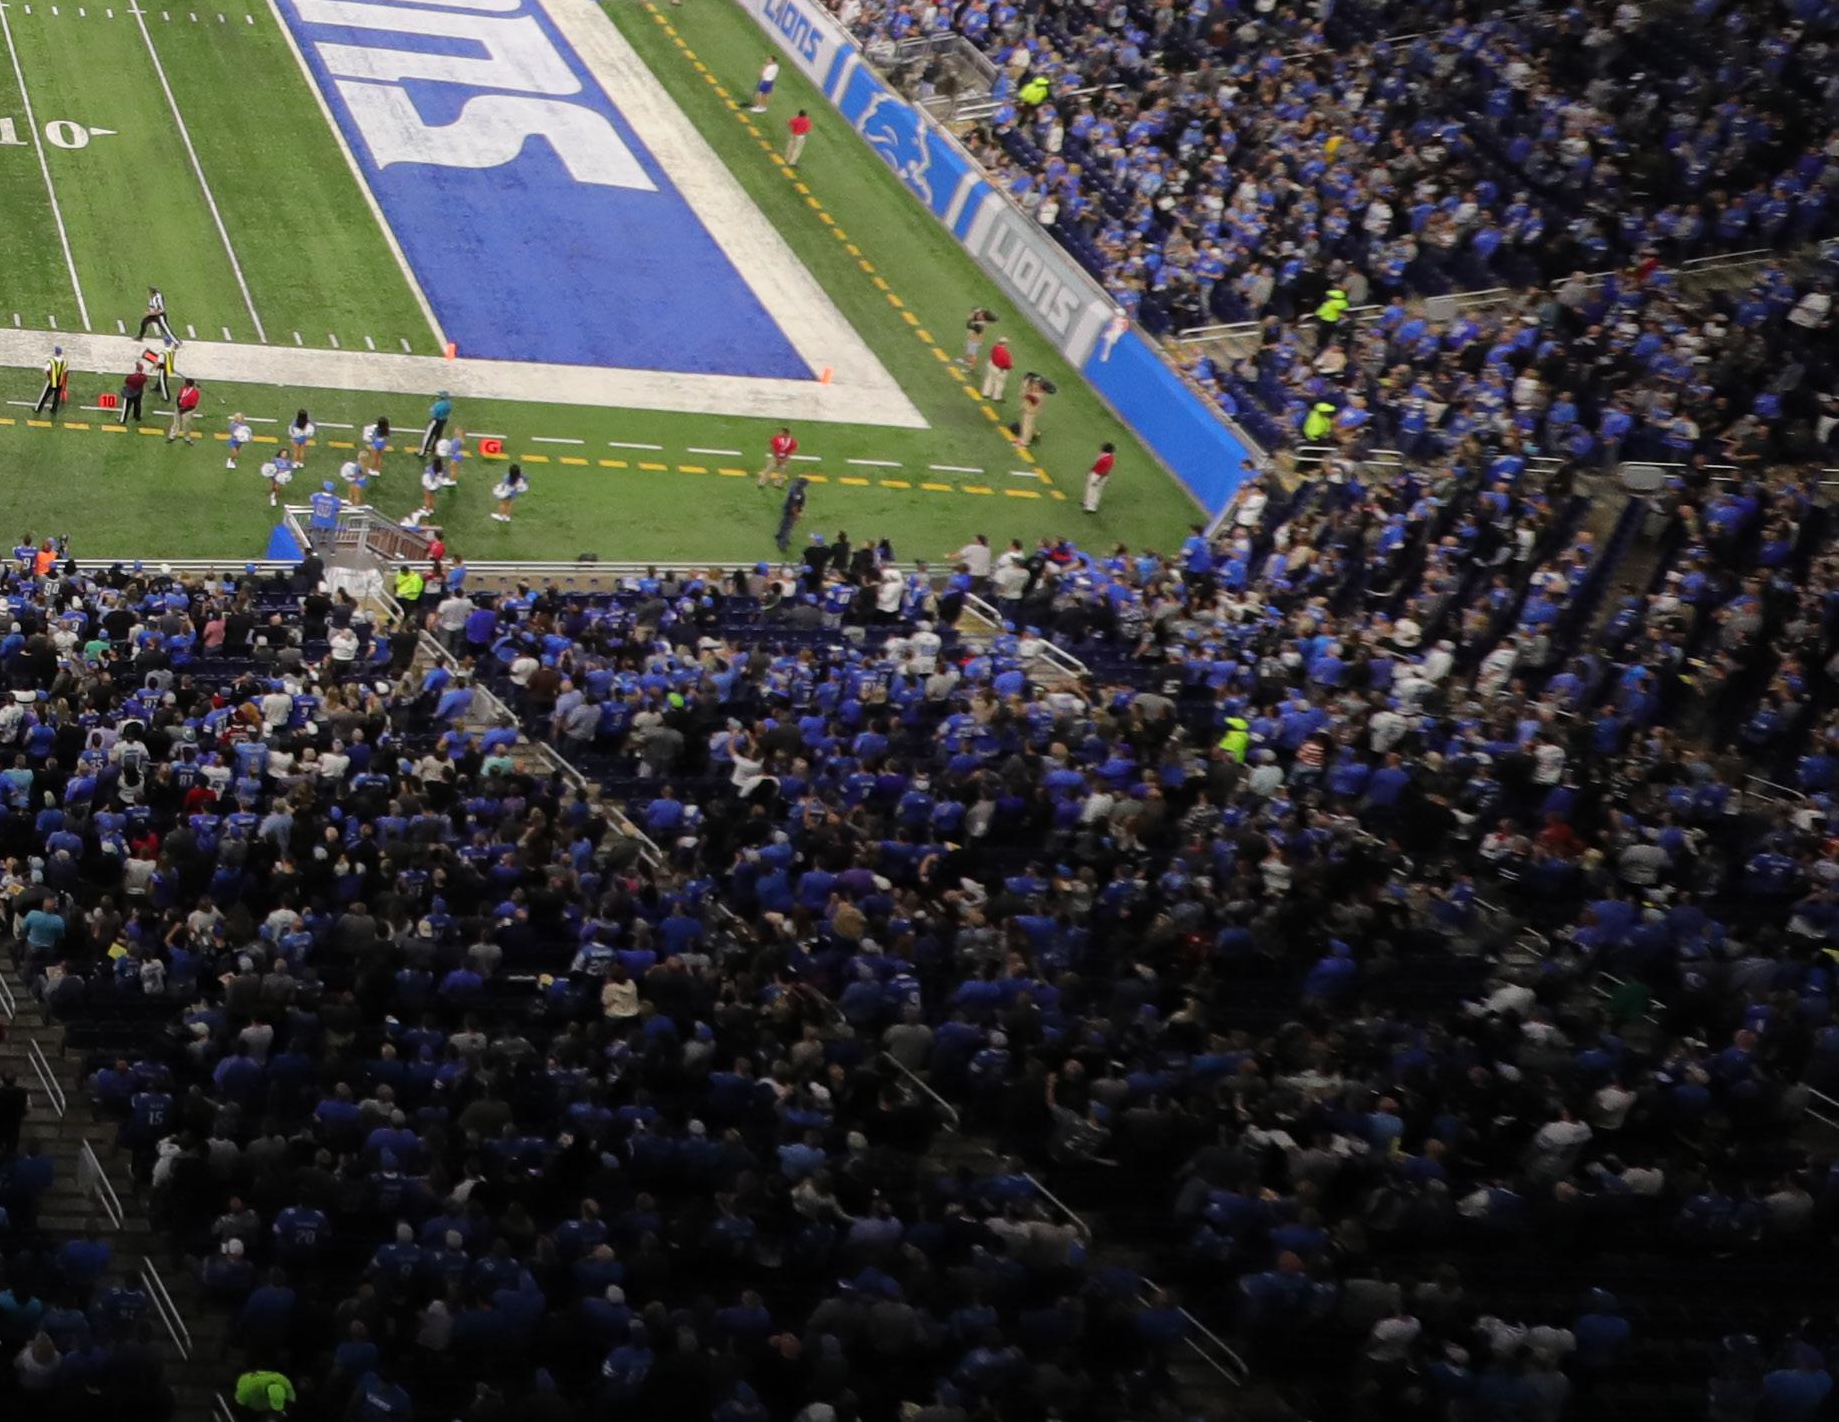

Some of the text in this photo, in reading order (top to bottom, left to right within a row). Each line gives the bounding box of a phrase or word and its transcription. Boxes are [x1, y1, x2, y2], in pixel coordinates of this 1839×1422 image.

[987, 222, 1081, 336] LIONS
[101, 395, 116, 408] 10
[485, 441, 498, 452] G
